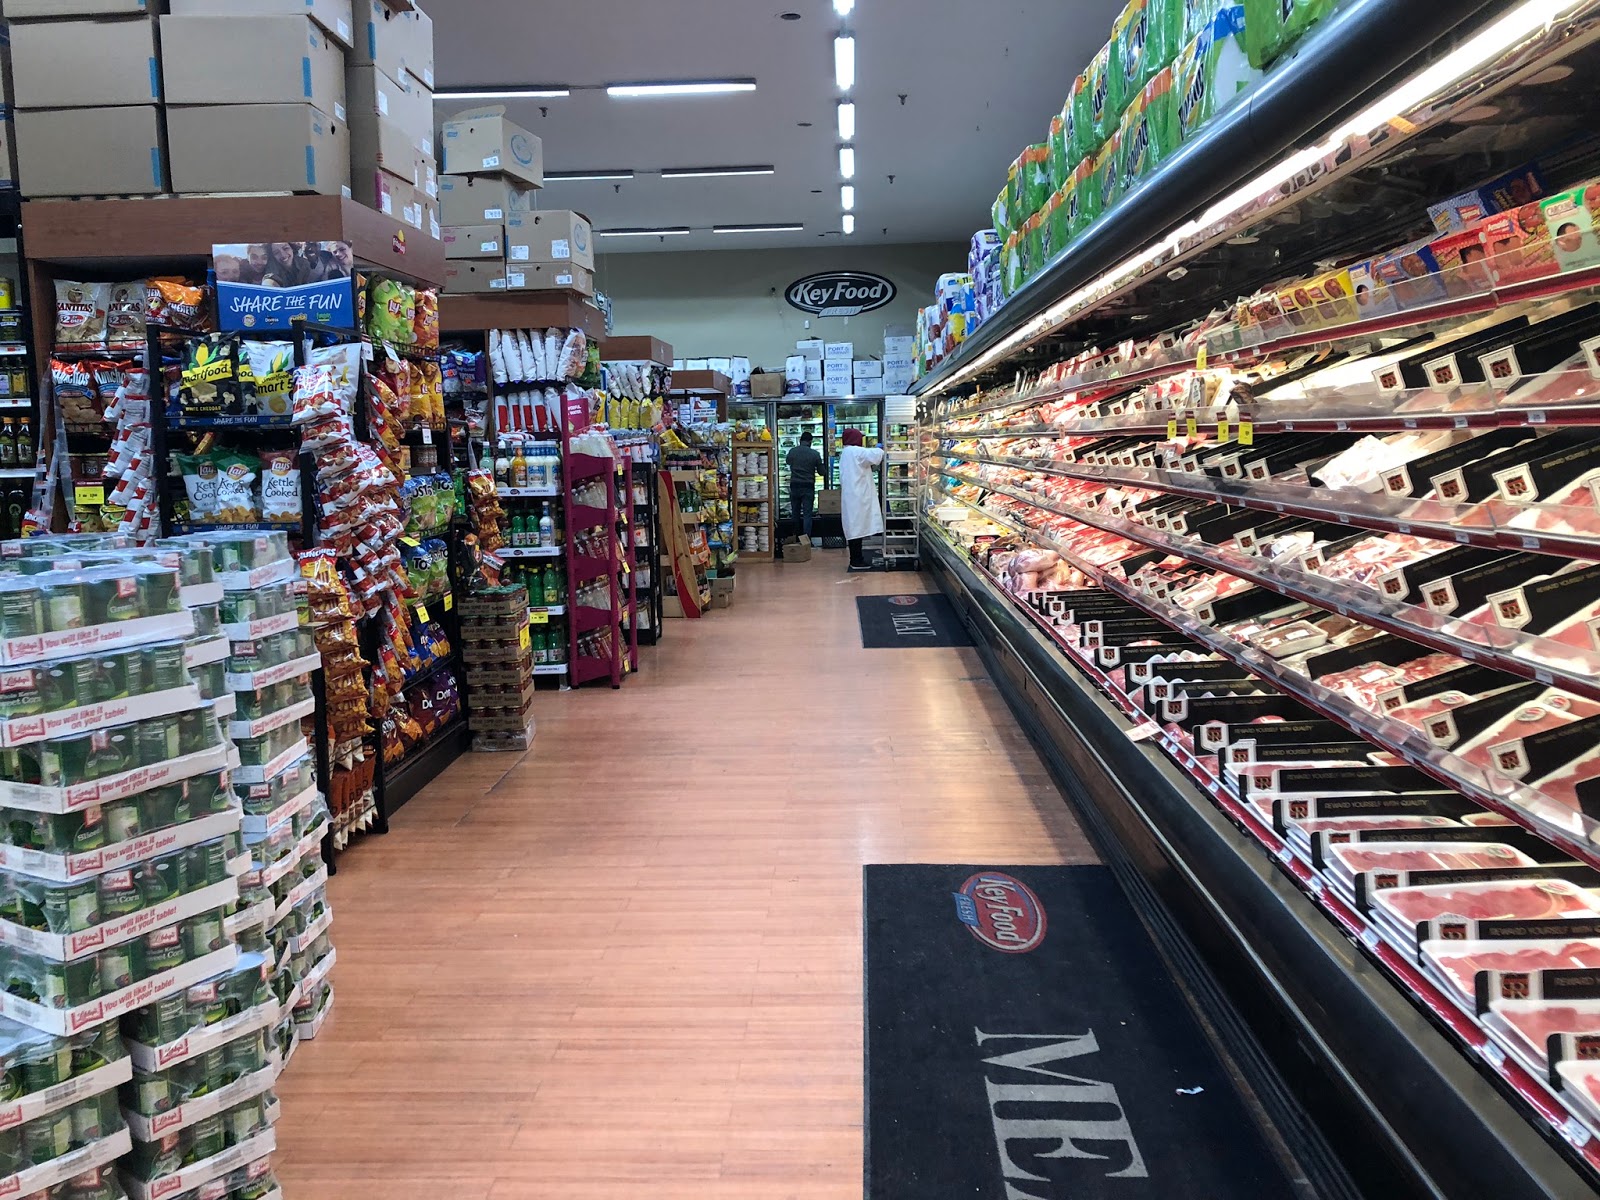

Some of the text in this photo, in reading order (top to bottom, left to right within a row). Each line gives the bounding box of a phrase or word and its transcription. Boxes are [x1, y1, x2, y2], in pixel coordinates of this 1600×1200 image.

[230, 293, 343, 313] SHARE THE FUN
[796, 282, 883, 305] Key Food
[56, 302, 93, 312] SANTITAS
[195, 481, 216, 492] Kett
[265, 488, 298, 498] Cooked
[267, 477, 294, 488] Kettle
[45, 639, 60, 648] You
[61, 636, 75, 645] will
[100, 630, 122, 641] table!
[46, 706, 103, 729] You will like it
[84, 717, 102, 728] your
[105, 706, 127, 719] table!
[102, 783, 114, 792] You
[130, 772, 142, 784] like
[142, 769, 149, 777] it
[133, 779, 149, 791] your
[150, 768, 170, 781] table!
[104, 836, 155, 861] You will like it
[137, 847, 154, 859] your
[156, 835, 176, 848] table!
[119, 894, 140, 904] Corn
[960, 896, 975, 921] FRESH
[105, 908, 155, 937] You will like it
[127, 906, 177, 935] on your table!
[975, 878, 1028, 944] Key Food
[104, 981, 153, 1012] You will like it
[126, 977, 175, 1008] on your table!
